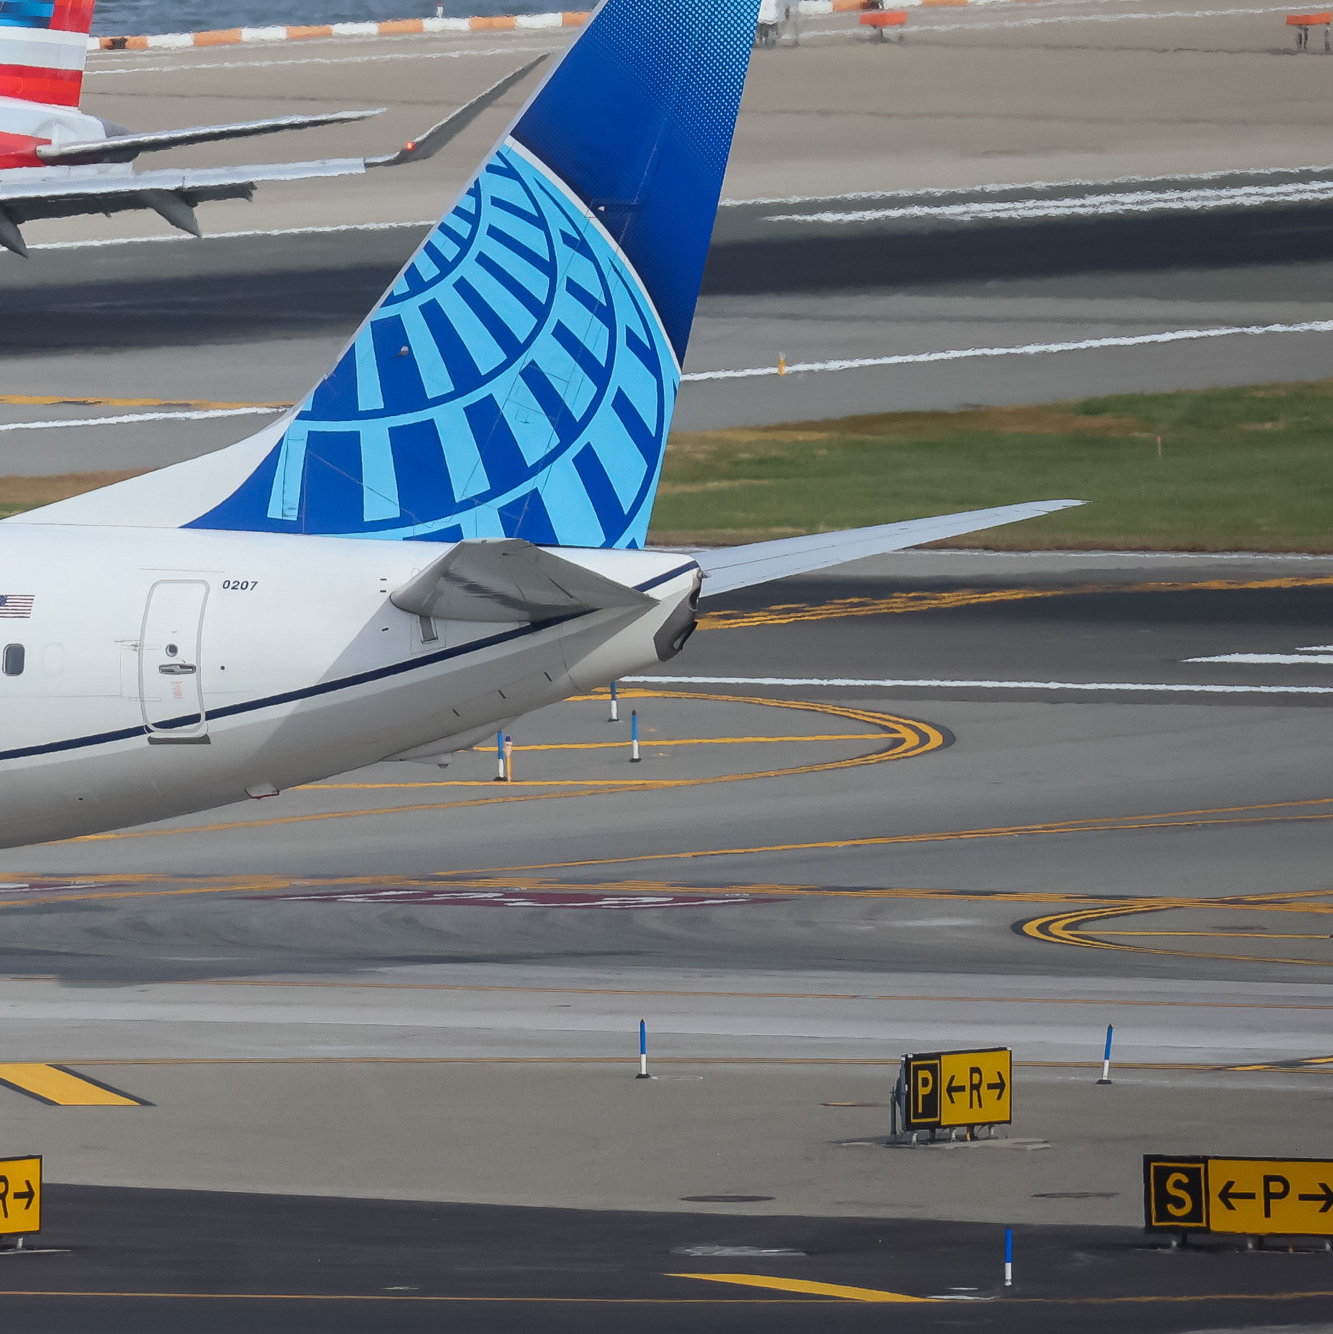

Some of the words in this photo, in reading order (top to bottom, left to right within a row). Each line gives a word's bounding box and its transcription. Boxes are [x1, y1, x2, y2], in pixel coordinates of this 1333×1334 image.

[222, 579, 259, 592] 0207
[917, 1070, 933, 1113] P
[969, 1066, 983, 1109] R
[1165, 1172, 1193, 1216] S
[1263, 1175, 1290, 1218] P
